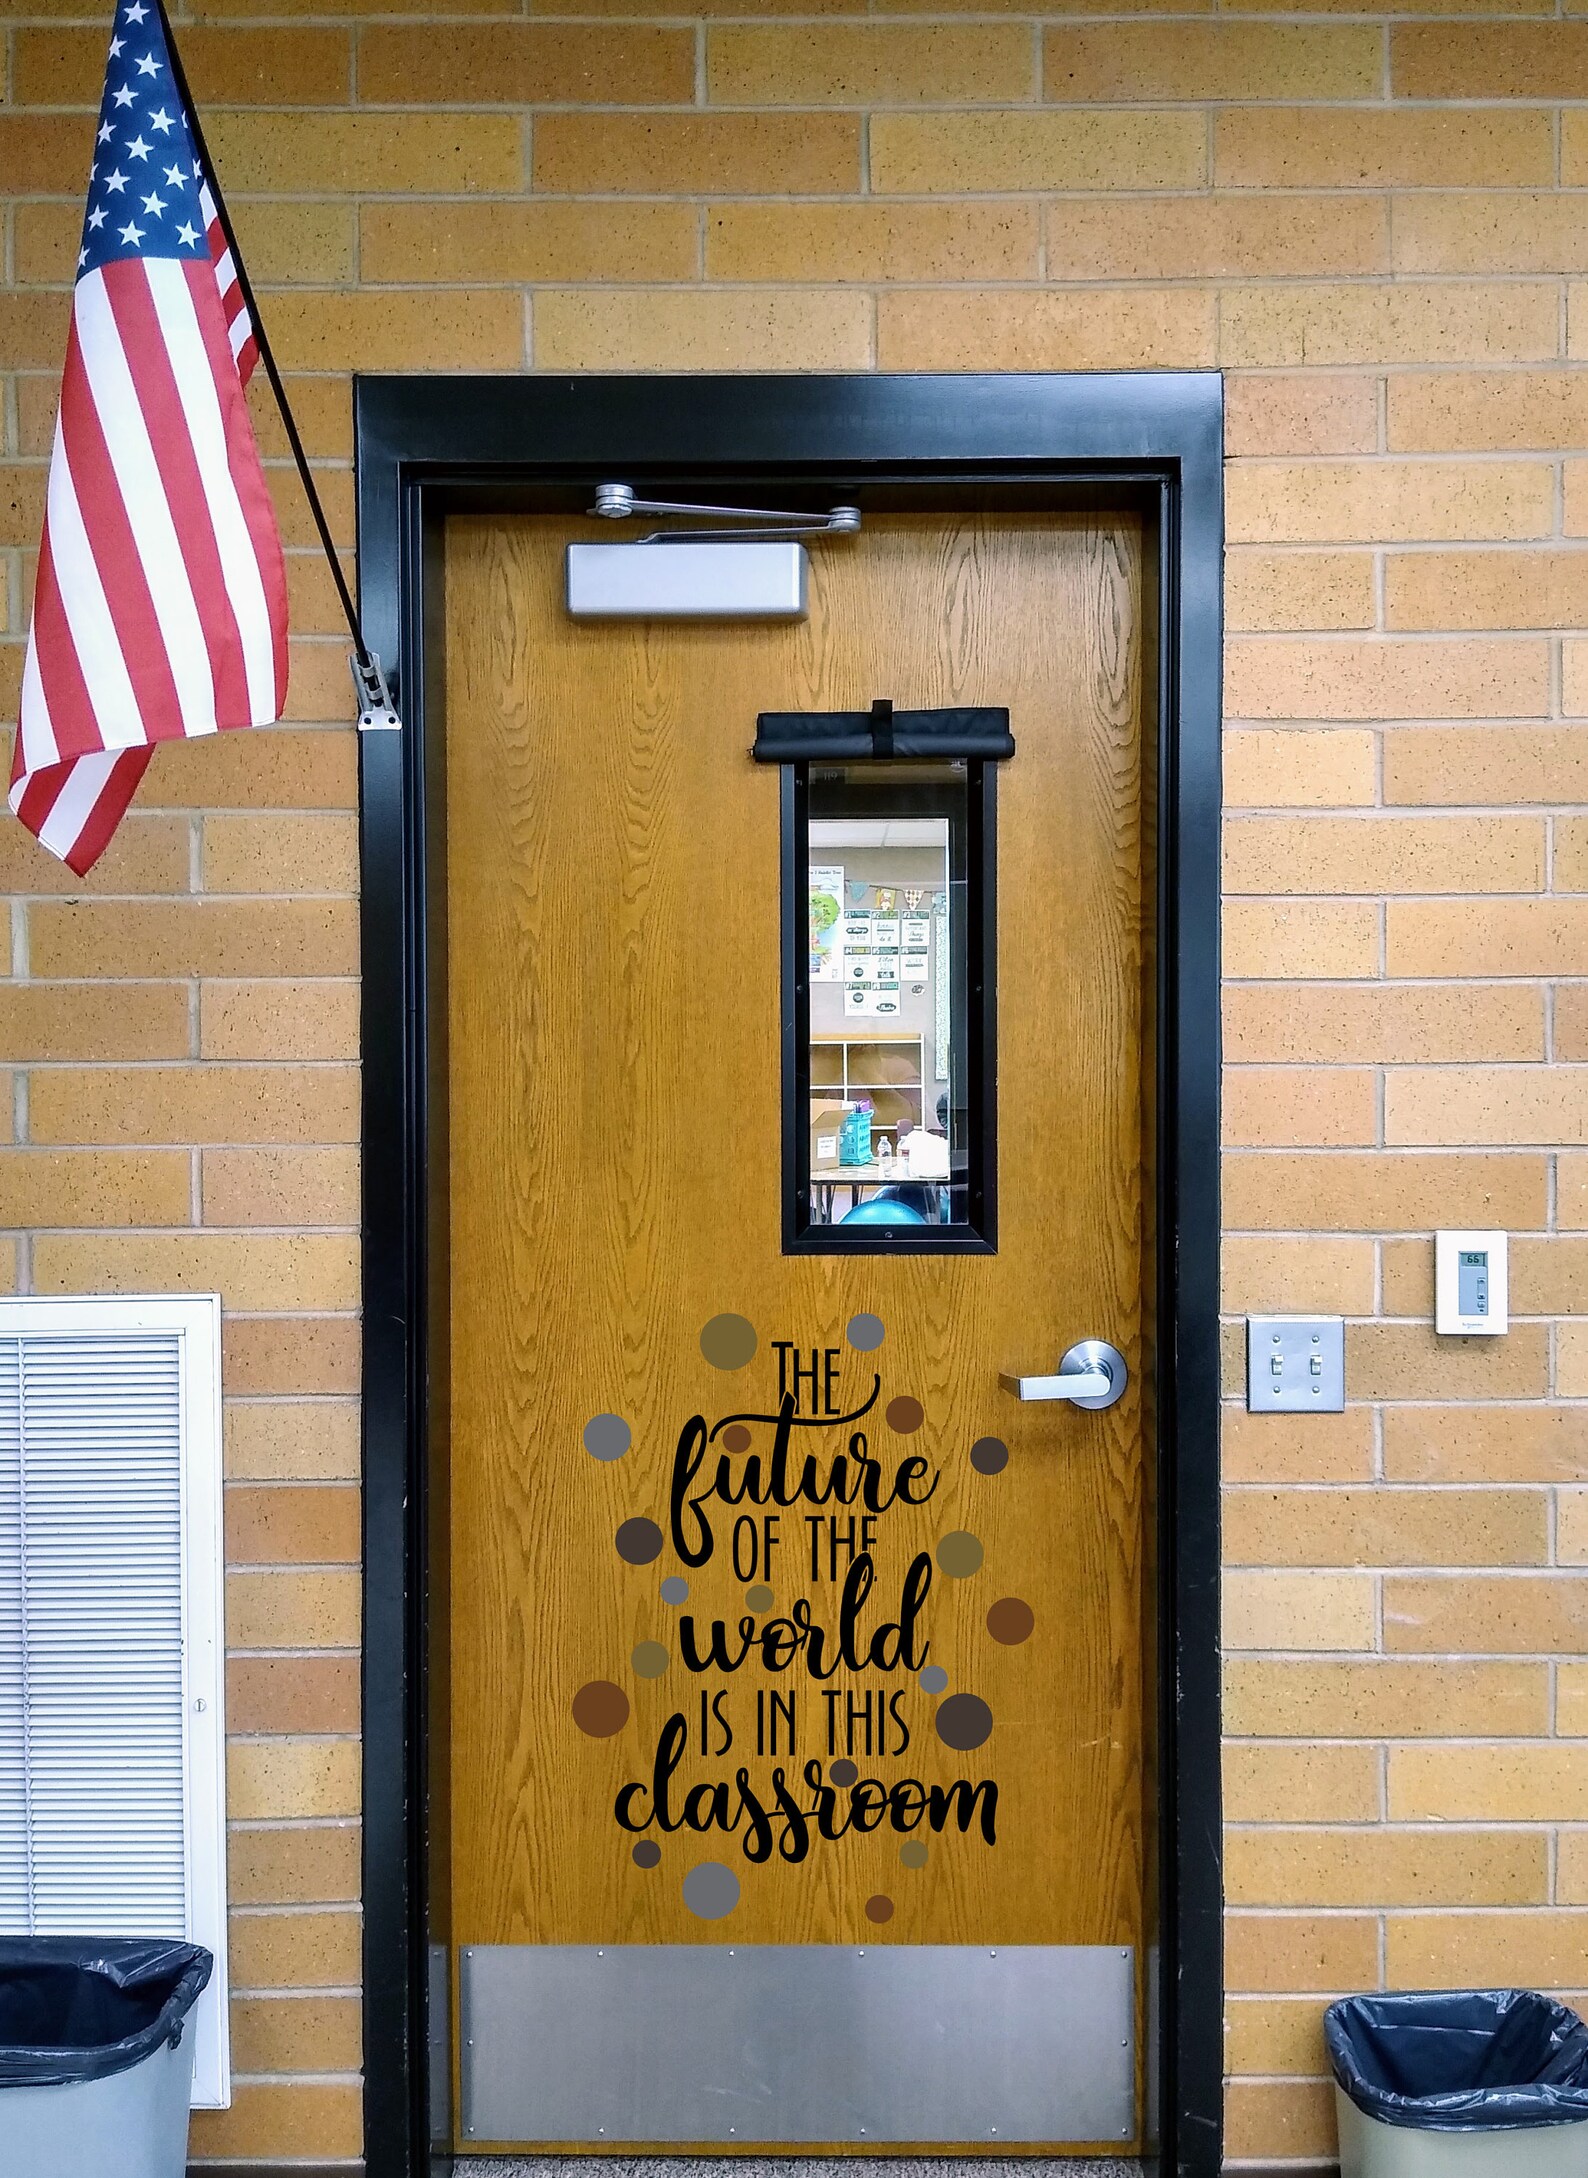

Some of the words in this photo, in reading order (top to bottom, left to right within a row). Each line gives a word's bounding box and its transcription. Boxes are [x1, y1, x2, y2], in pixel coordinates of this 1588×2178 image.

[771, 1341, 841, 1415] THE
[670, 1373, 940, 1568] future
[732, 1516, 780, 1583] OF
[804, 1516, 878, 1583] THE
[679, 1551, 933, 1680] world
[701, 1689, 733, 1757] IS
[757, 1689, 796, 1757] IN
[821, 1689, 910, 1757] THIS
[614, 1712, 999, 1864] classroom
